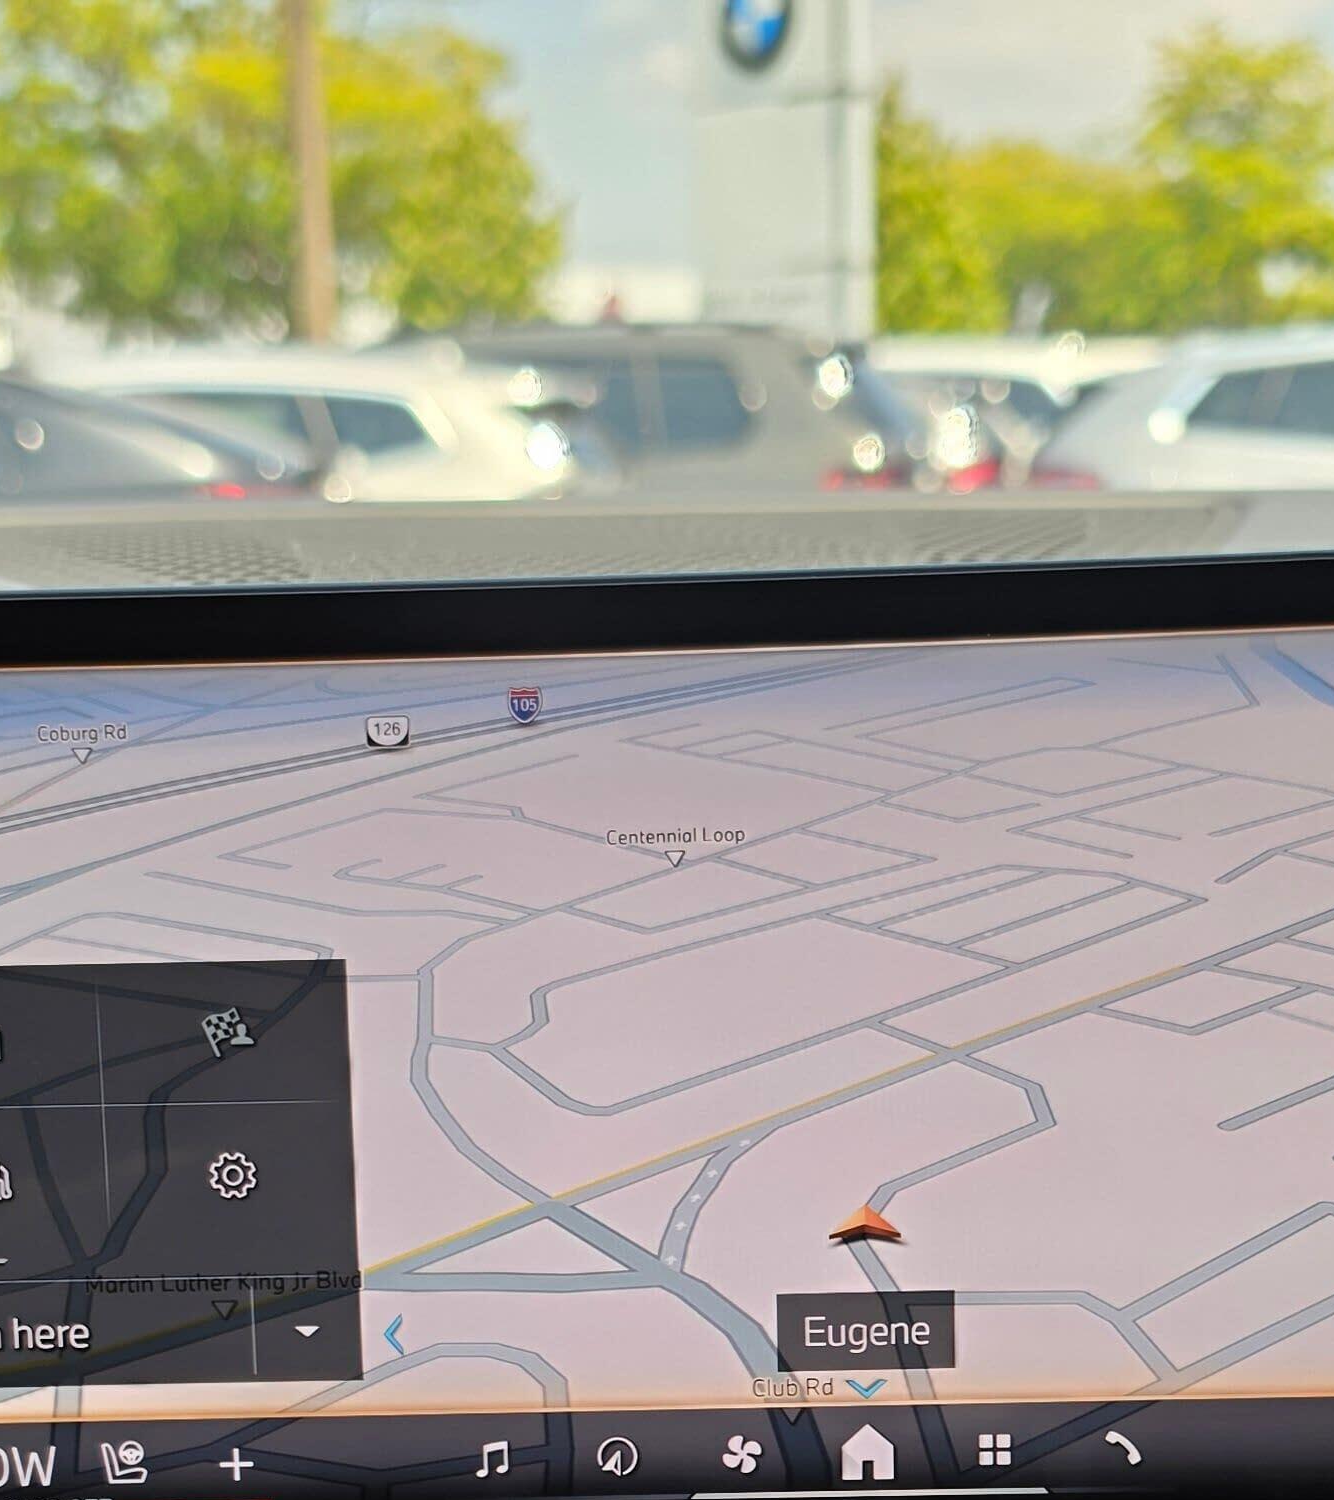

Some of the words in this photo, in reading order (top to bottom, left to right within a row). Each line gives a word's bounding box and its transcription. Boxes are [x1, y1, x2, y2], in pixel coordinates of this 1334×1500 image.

[511, 697, 538, 713] 105
[36, 723, 99, 745] Coburg
[103, 722, 128, 742] Rd
[373, 721, 402, 738] 126
[605, 827, 698, 847] Centennial
[701, 826, 746, 847] Loop
[85, 1274, 155, 1294] Martin
[161, 1272, 230, 1293] Luther
[237, 1272, 285, 1296] King
[316, 1270, 363, 1290] Blvd
[10, 1315, 91, 1353] here
[804, 1316, 930, 1353] Eugene
[751, 1376, 802, 1400] Club
[806, 1375, 835, 1398] Rd
